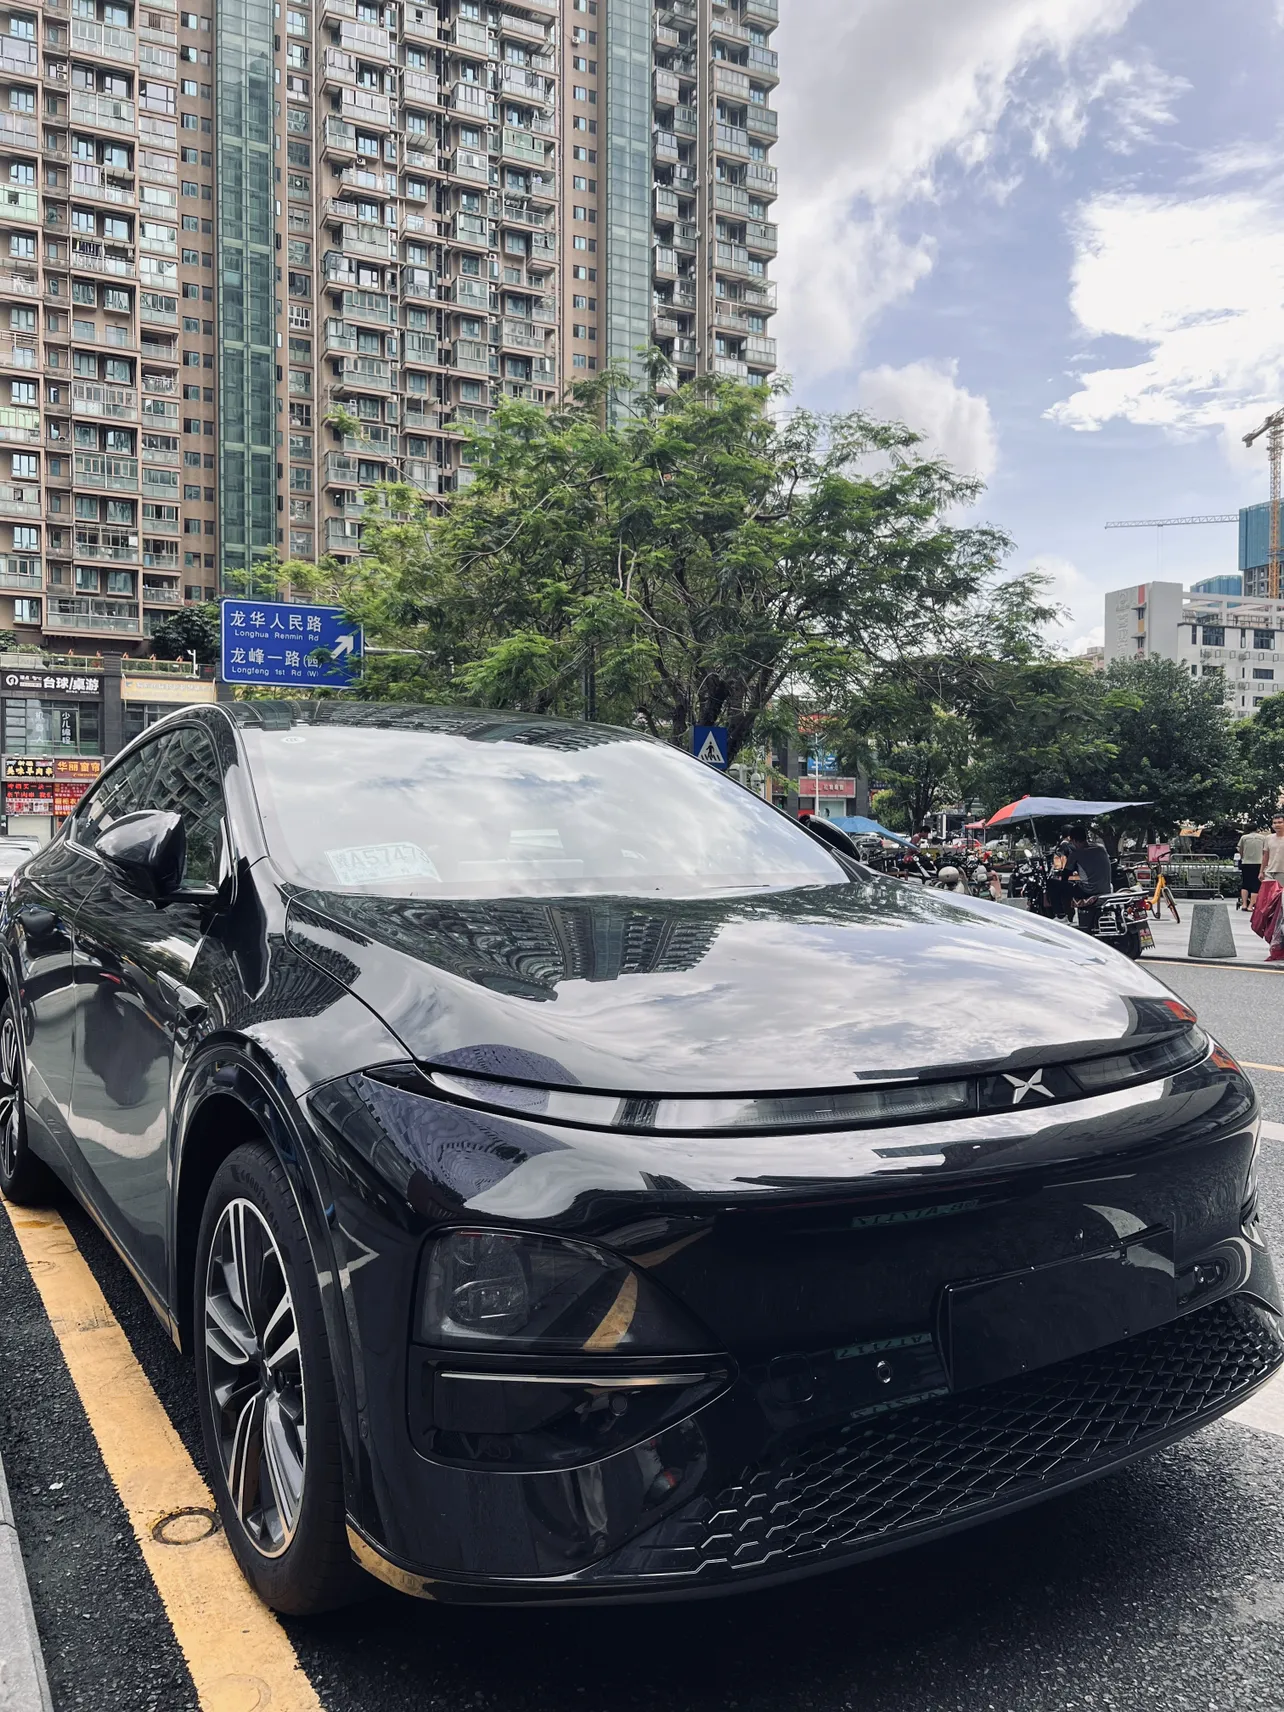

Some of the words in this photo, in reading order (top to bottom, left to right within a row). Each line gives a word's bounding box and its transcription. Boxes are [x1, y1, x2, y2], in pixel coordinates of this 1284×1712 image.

[230, 610, 322, 633] 龙华人民路
[234, 629, 269, 639] Longhua
[274, 632, 303, 641] Renmin
[308, 634, 320, 642] Rd
[231, 666, 270, 677] Longfeng
[275, 668, 286, 676] 1st
[291, 669, 302, 677] Rd
[307, 670, 319, 678] (W)
[43, 677, 99, 691] 台球/桌游
